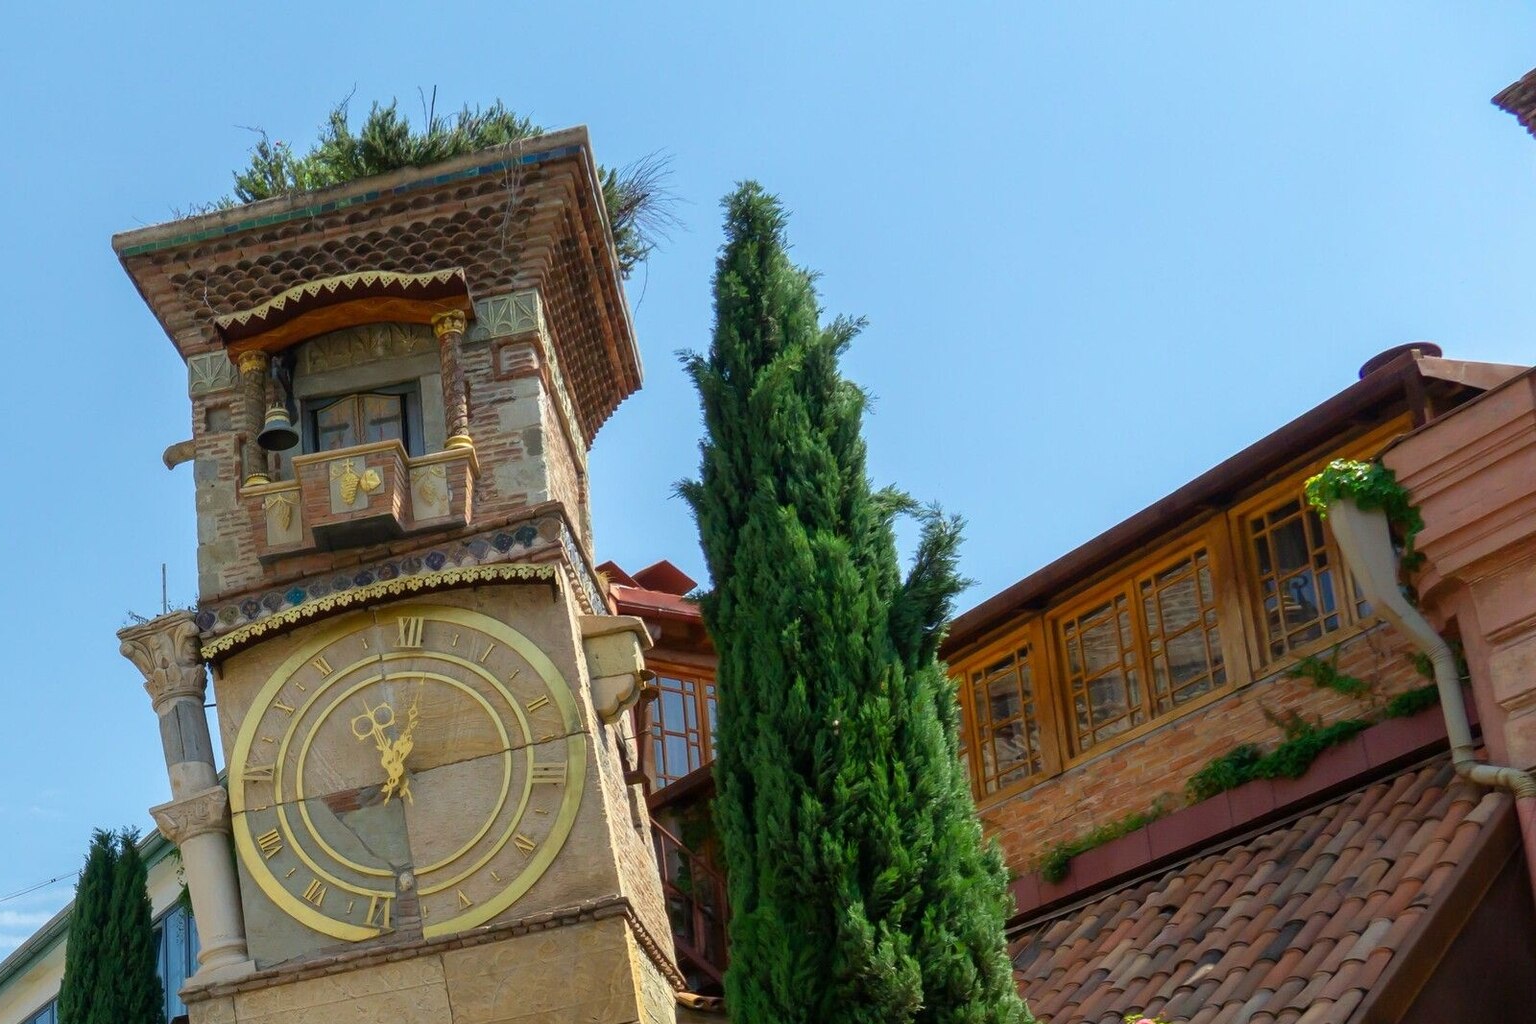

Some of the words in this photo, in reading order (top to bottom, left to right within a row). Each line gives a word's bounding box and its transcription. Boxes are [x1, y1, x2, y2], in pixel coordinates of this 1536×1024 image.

[391, 616, 423, 648] XII
[312, 656, 334, 679] XI
[274, 699, 296, 716] X
[525, 694, 551, 713] II
[533, 760, 567, 786] III
[257, 828, 283, 859] VIII
[302, 878, 328, 907] VII
[457, 889, 473, 911] V
[364, 894, 395, 932] VI
